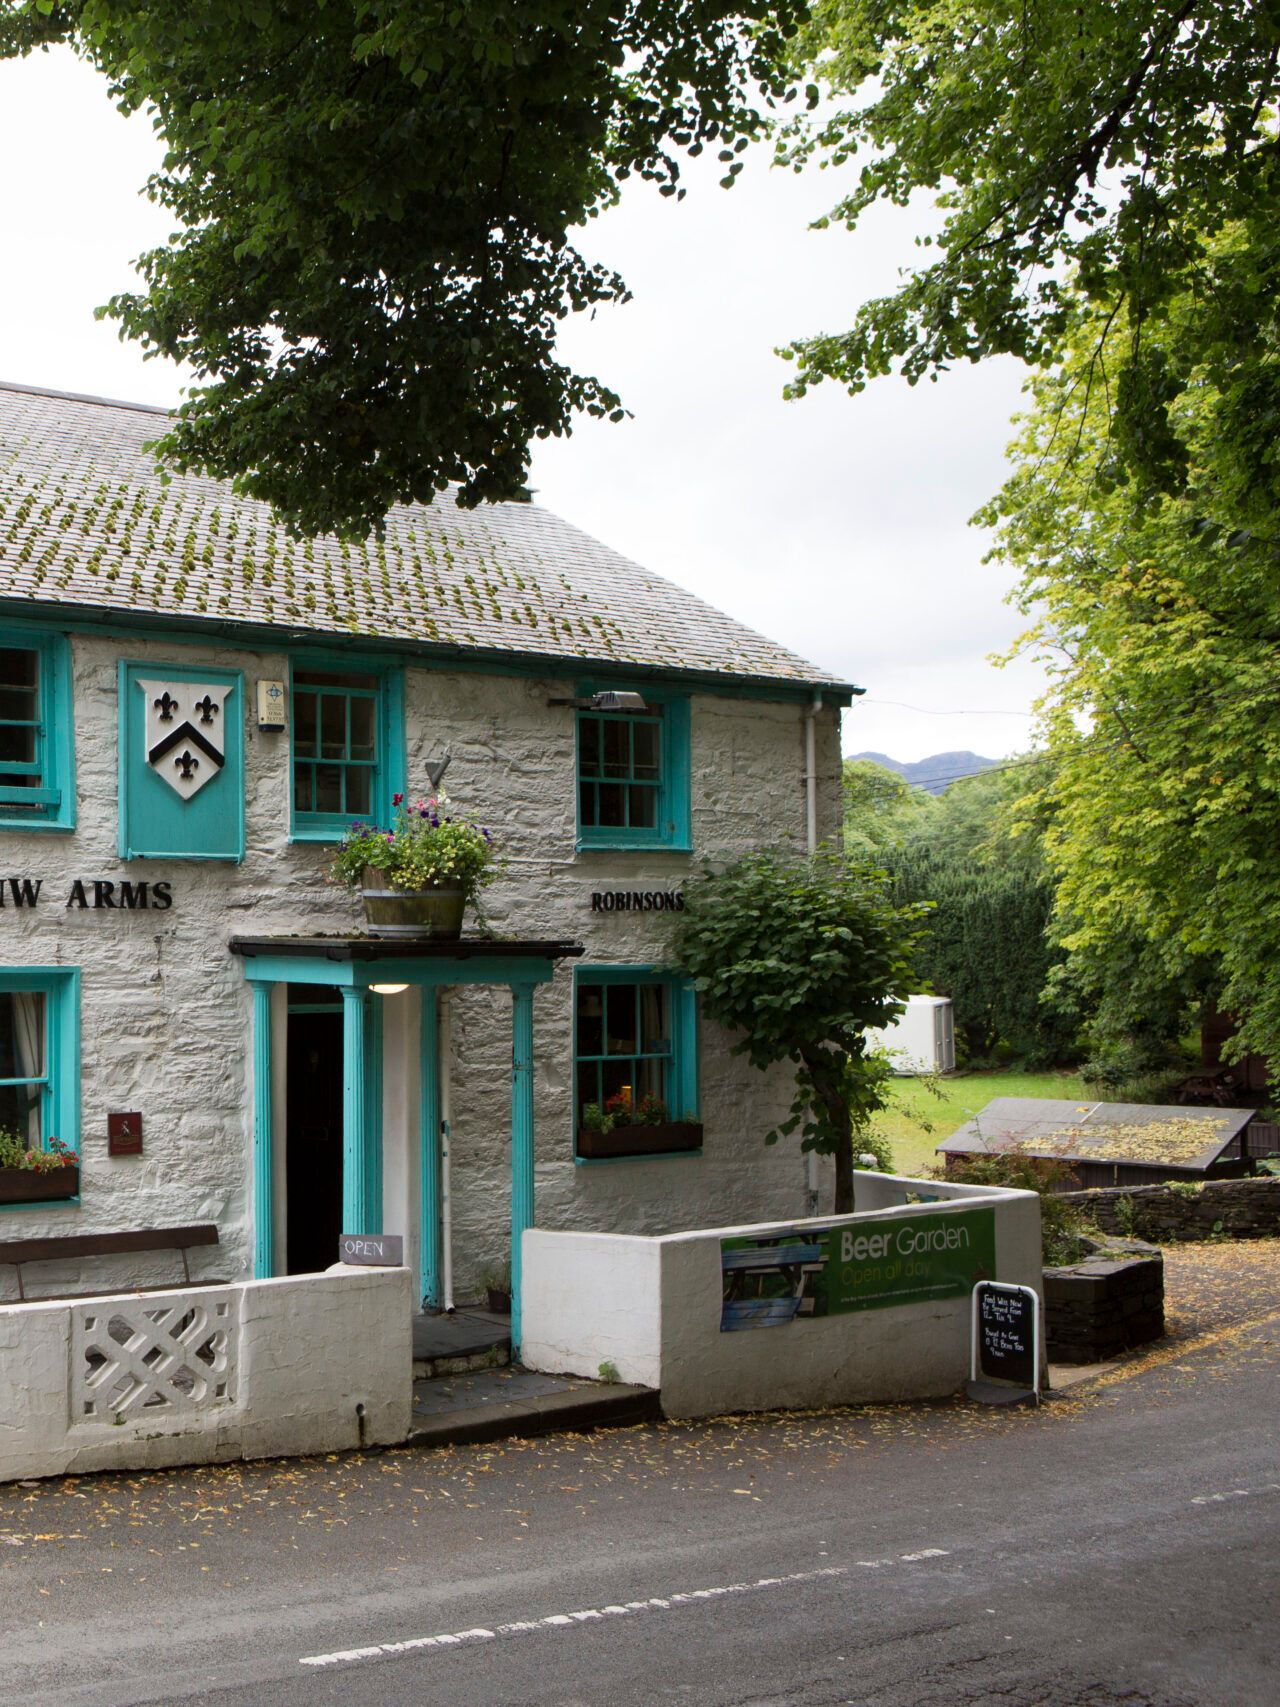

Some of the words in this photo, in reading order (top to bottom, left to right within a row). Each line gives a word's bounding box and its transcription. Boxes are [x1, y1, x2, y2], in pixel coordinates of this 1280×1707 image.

[65, 880, 173, 910] ARMS
[591, 891, 685, 912] ROBINSONS
[344, 1240, 383, 1256] OPEN
[841, 1231, 892, 1262] Beer
[896, 1222, 970, 1255] Garden
[842, 1267, 881, 1288] Open
[885, 1259, 901, 1279] all
[905, 1259, 929, 1278] day
